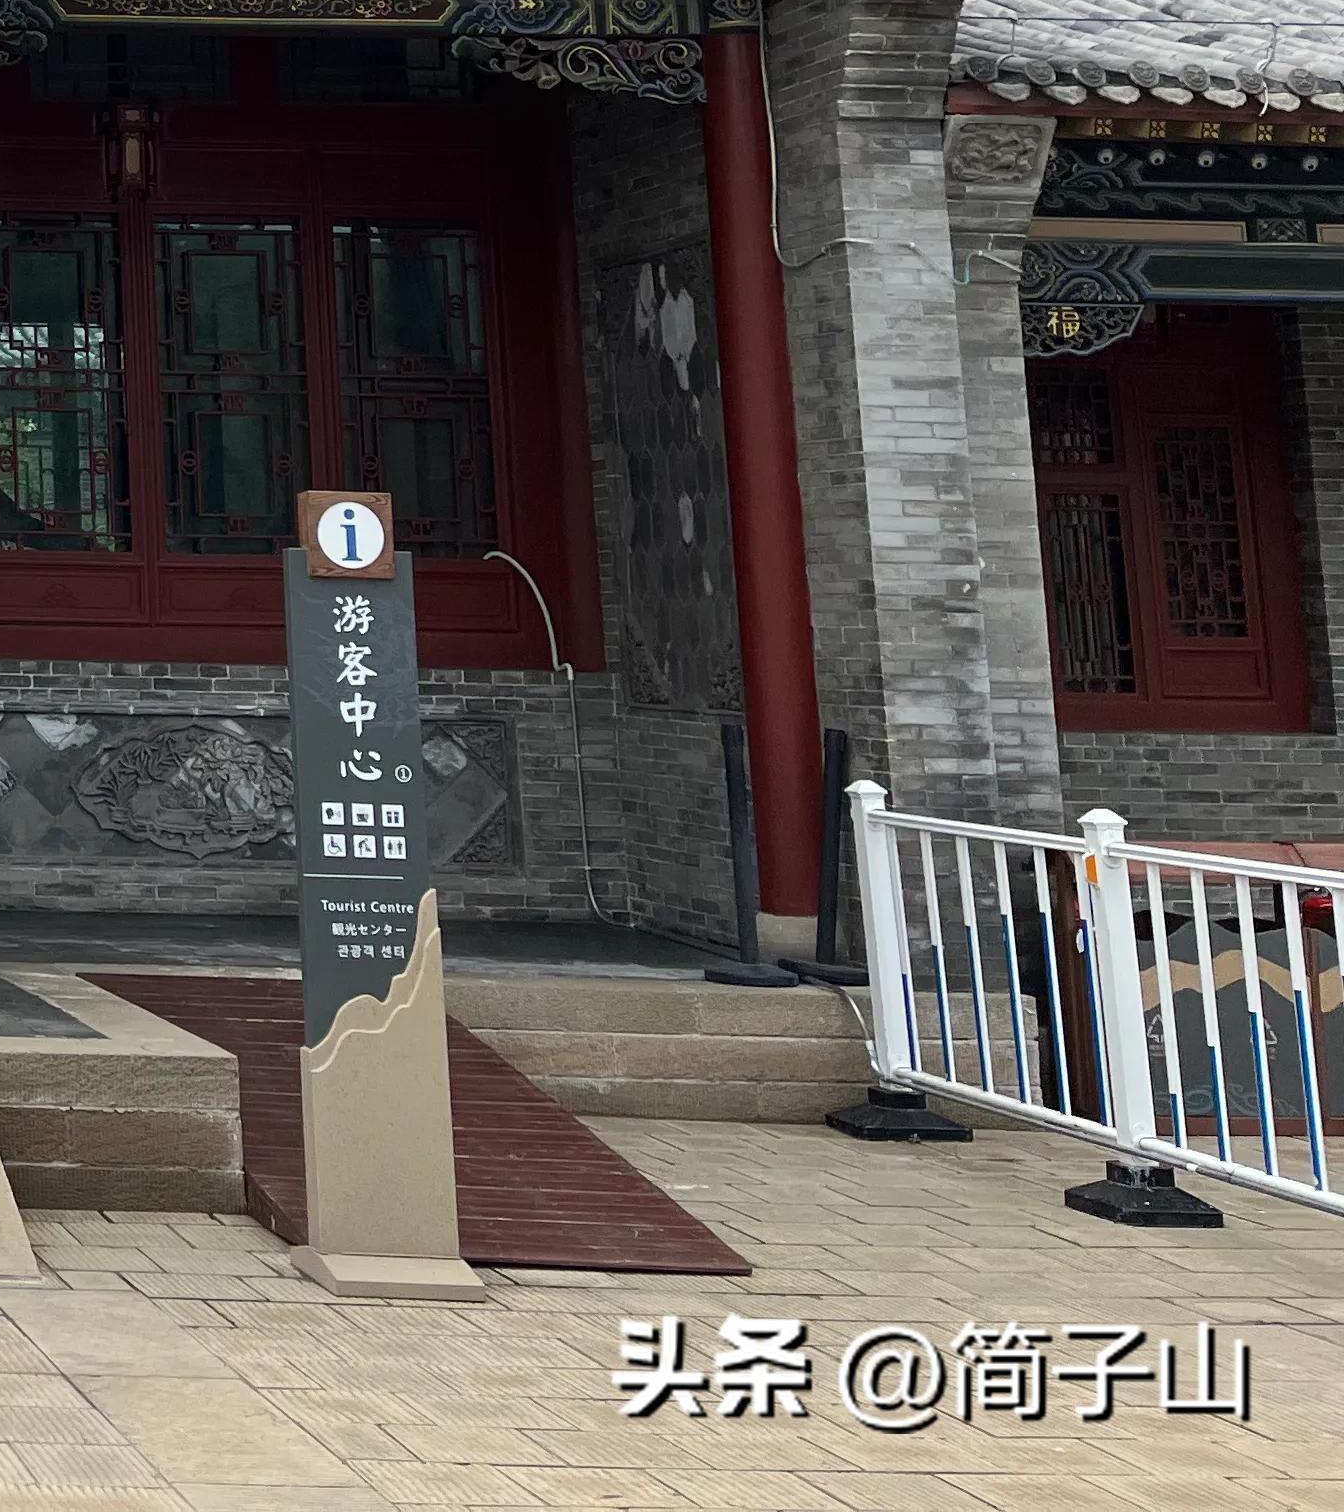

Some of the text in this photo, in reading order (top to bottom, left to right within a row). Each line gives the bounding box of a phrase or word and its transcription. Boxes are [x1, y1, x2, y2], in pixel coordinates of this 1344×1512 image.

[1047, 306, 1081, 338] 福
[332, 595, 383, 781] 游客中心
[320, 899, 414, 914] Tourist Centre
[381, 945, 405, 959] 센터
